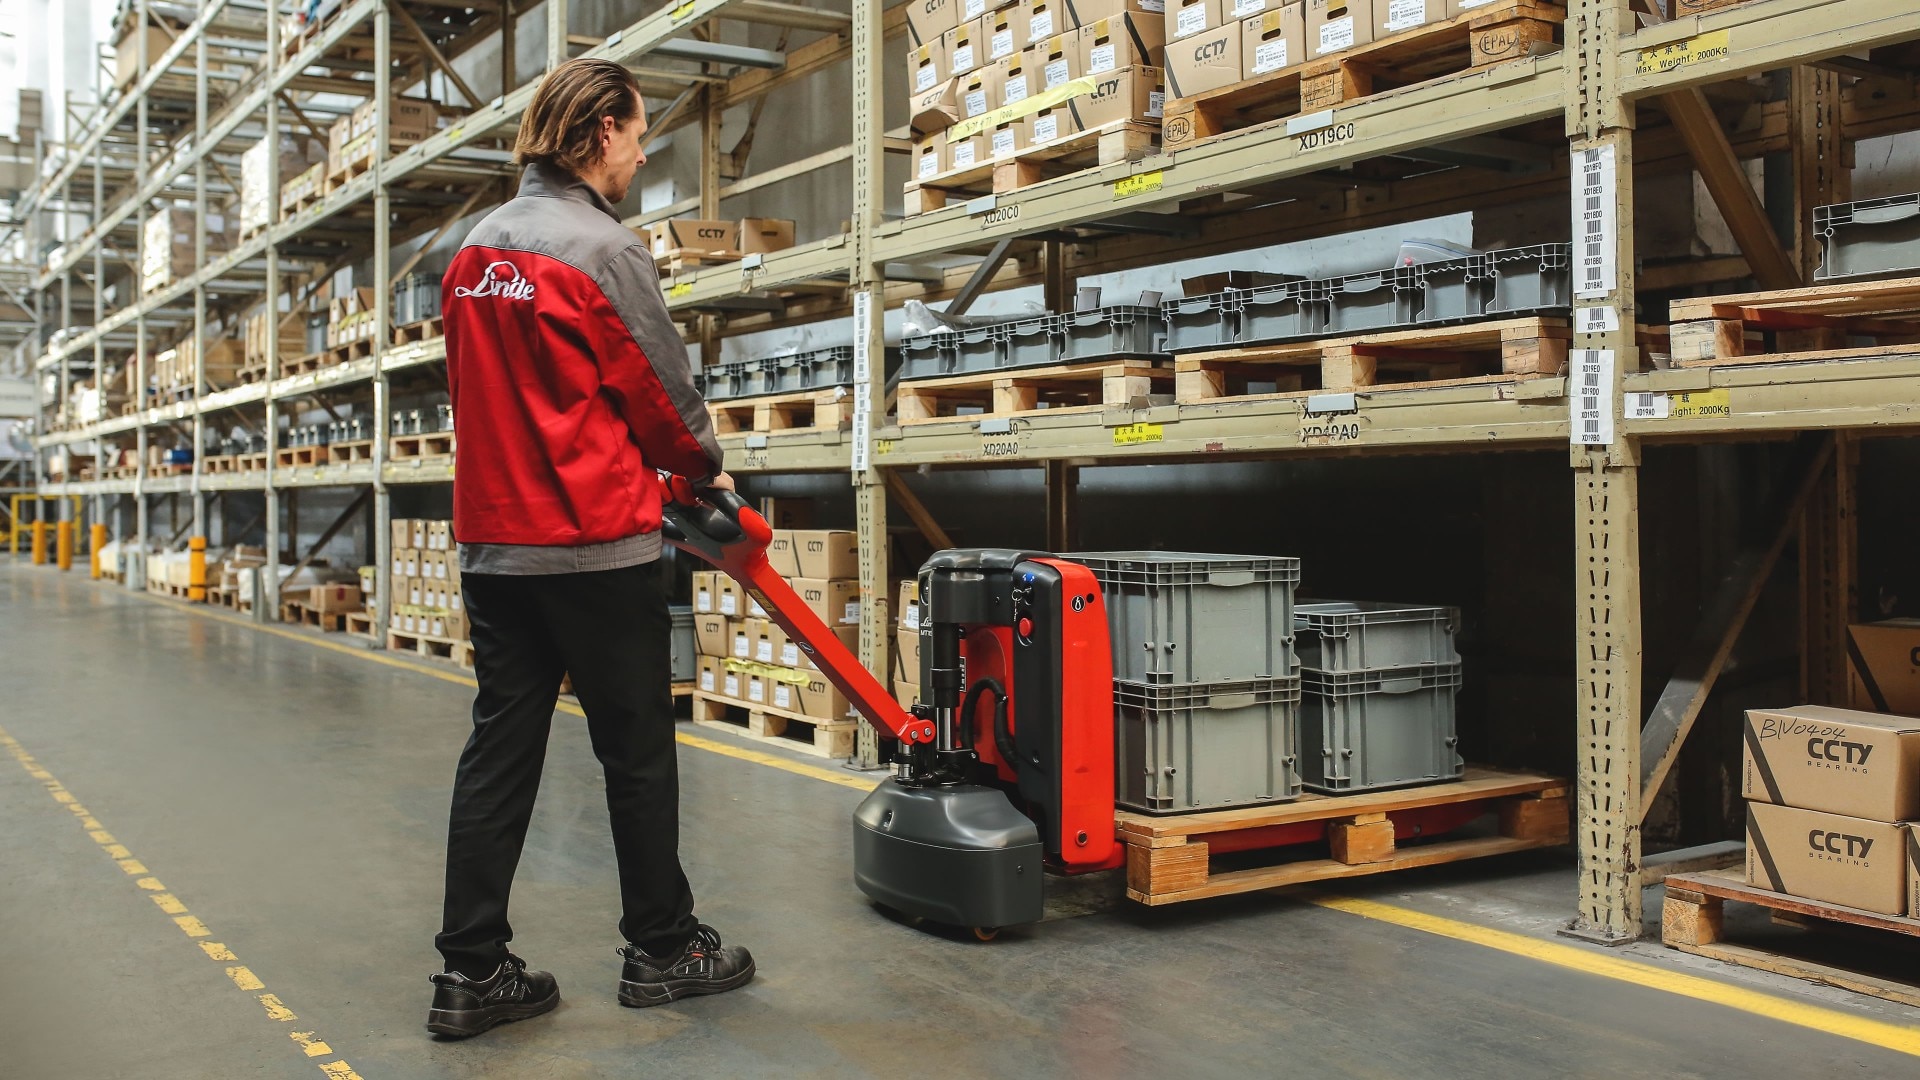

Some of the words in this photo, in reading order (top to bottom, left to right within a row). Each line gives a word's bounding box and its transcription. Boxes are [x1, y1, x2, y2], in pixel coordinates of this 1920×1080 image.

[1483, 33, 1512, 51] EPAL
[1194, 38, 1228, 62] CCTY
[1635, 64, 1655, 75] Max.
[1697, 46, 1728, 60] 2000Kg
[1166, 122, 1187, 139] EPAL
[1299, 122, 1354, 151] XD19C0
[984, 205, 1019, 225] XD20C0
[698, 228, 726, 239] CCTY
[455, 260, 535, 300] Linde
[1699, 405, 1730, 415] 2000Kg
[983, 442, 1018, 456] XD20A0
[773, 539, 788, 551] CCTY
[807, 540, 824, 552] CCTY
[805, 589, 822, 601] CCTY
[706, 622, 719, 633] CCTY
[808, 680, 827, 693] CCTY
[1807, 737, 1874, 765] CCTY
[1808, 760, 1868, 774] BEARING
[1808, 829, 1874, 858] CCTY
[1809, 852, 1869, 867] BEARING
